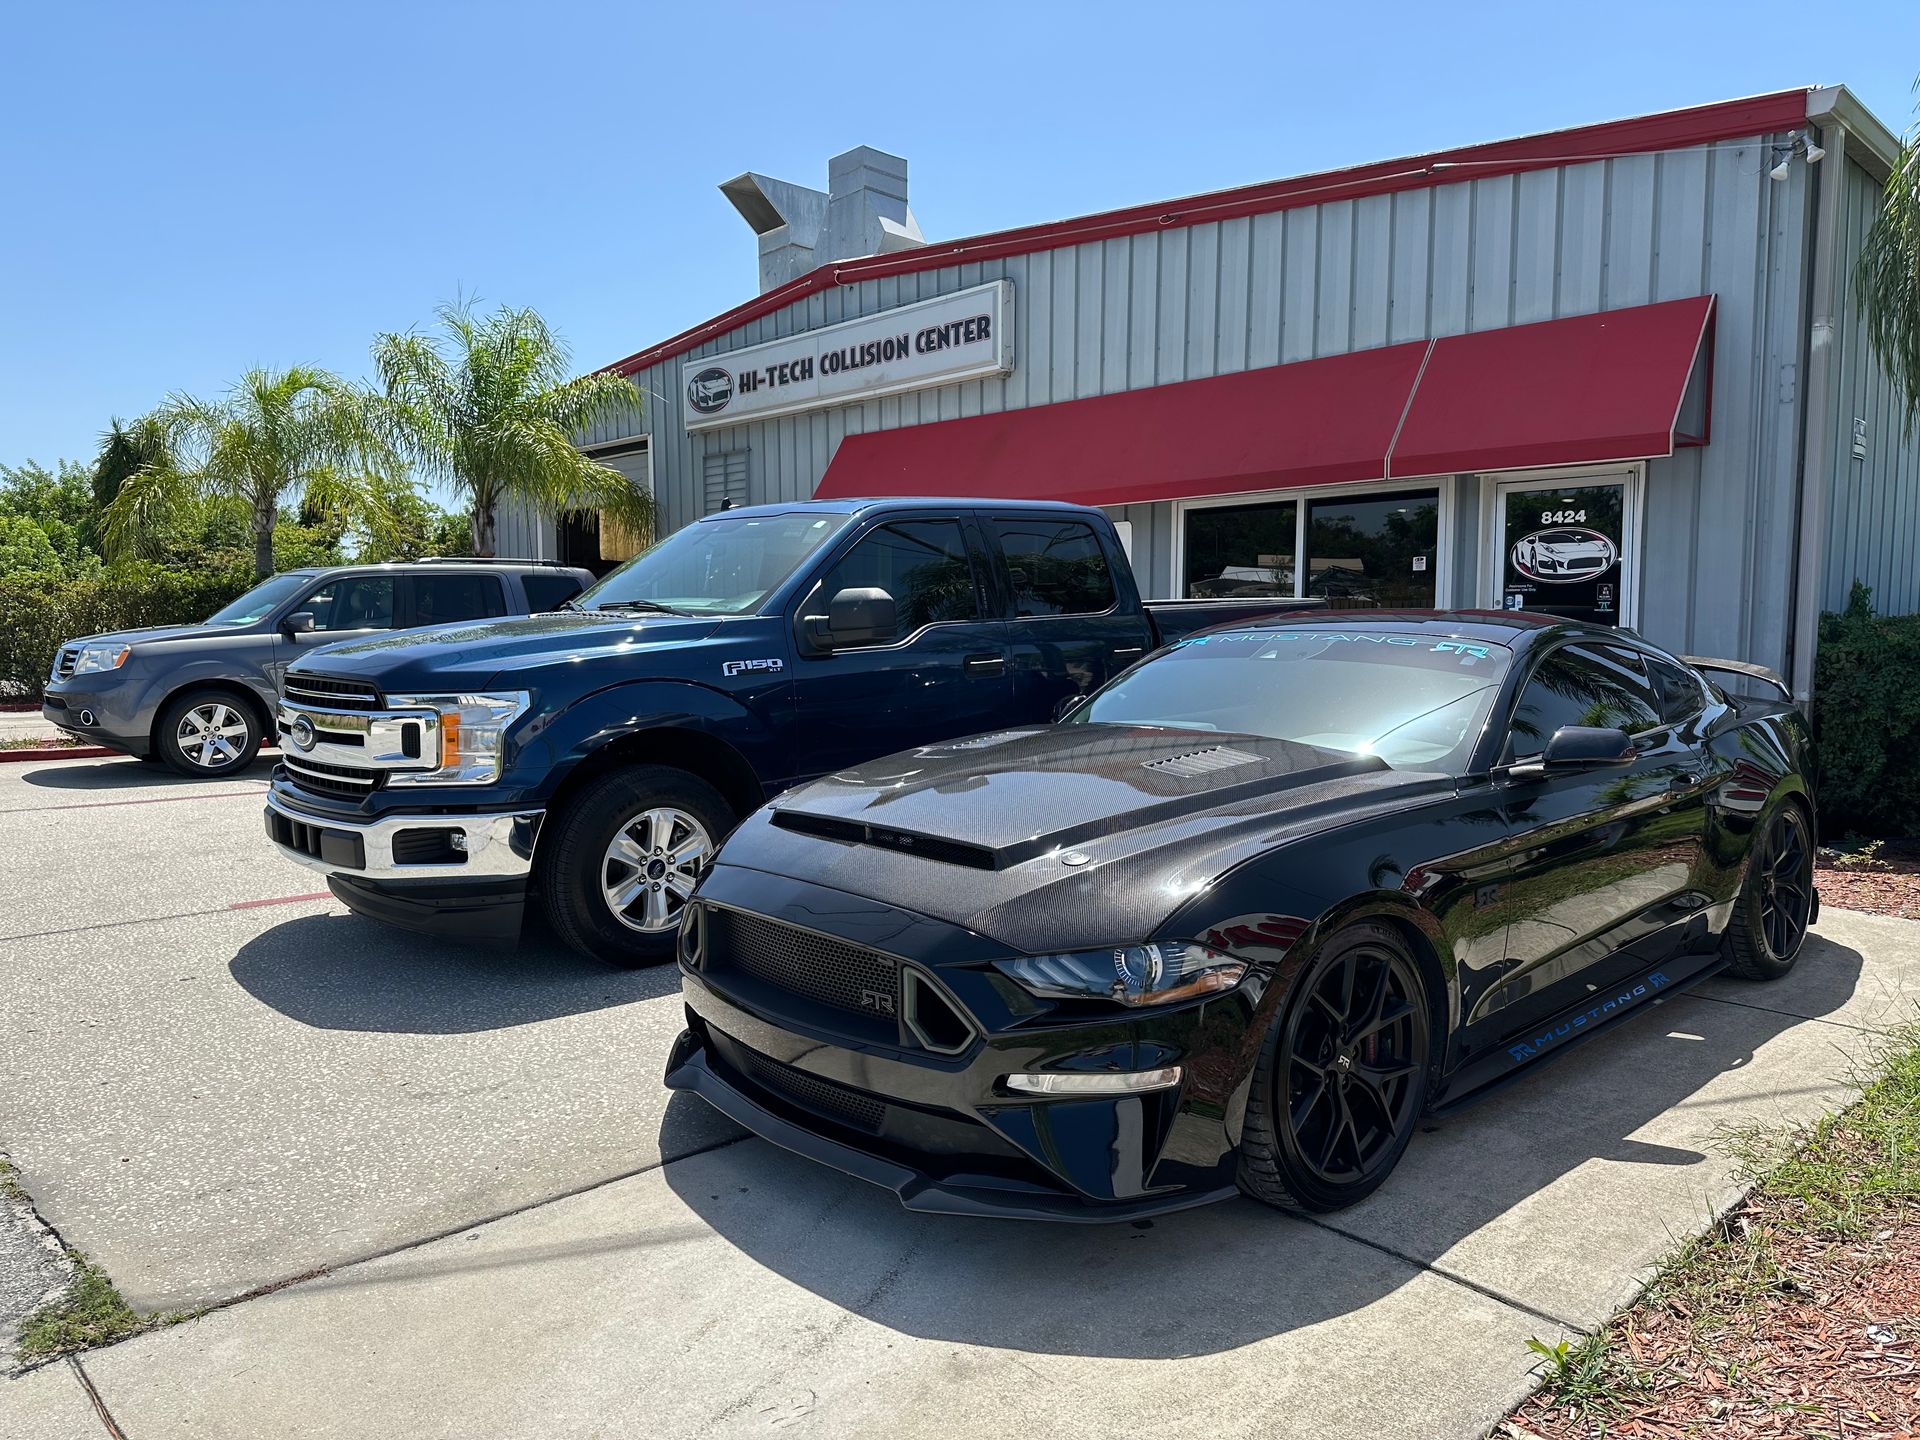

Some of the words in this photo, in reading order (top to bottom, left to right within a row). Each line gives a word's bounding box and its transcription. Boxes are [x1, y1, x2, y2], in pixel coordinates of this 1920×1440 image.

[738, 356, 814, 394] HI-TECH
[819, 334, 910, 376] COLLISION
[915, 313, 991, 354] CENTER
[1540, 509, 1587, 524] 8424
[1218, 634, 1418, 646] MUSTANG
[1534, 983, 1647, 1048] MUSTANG
